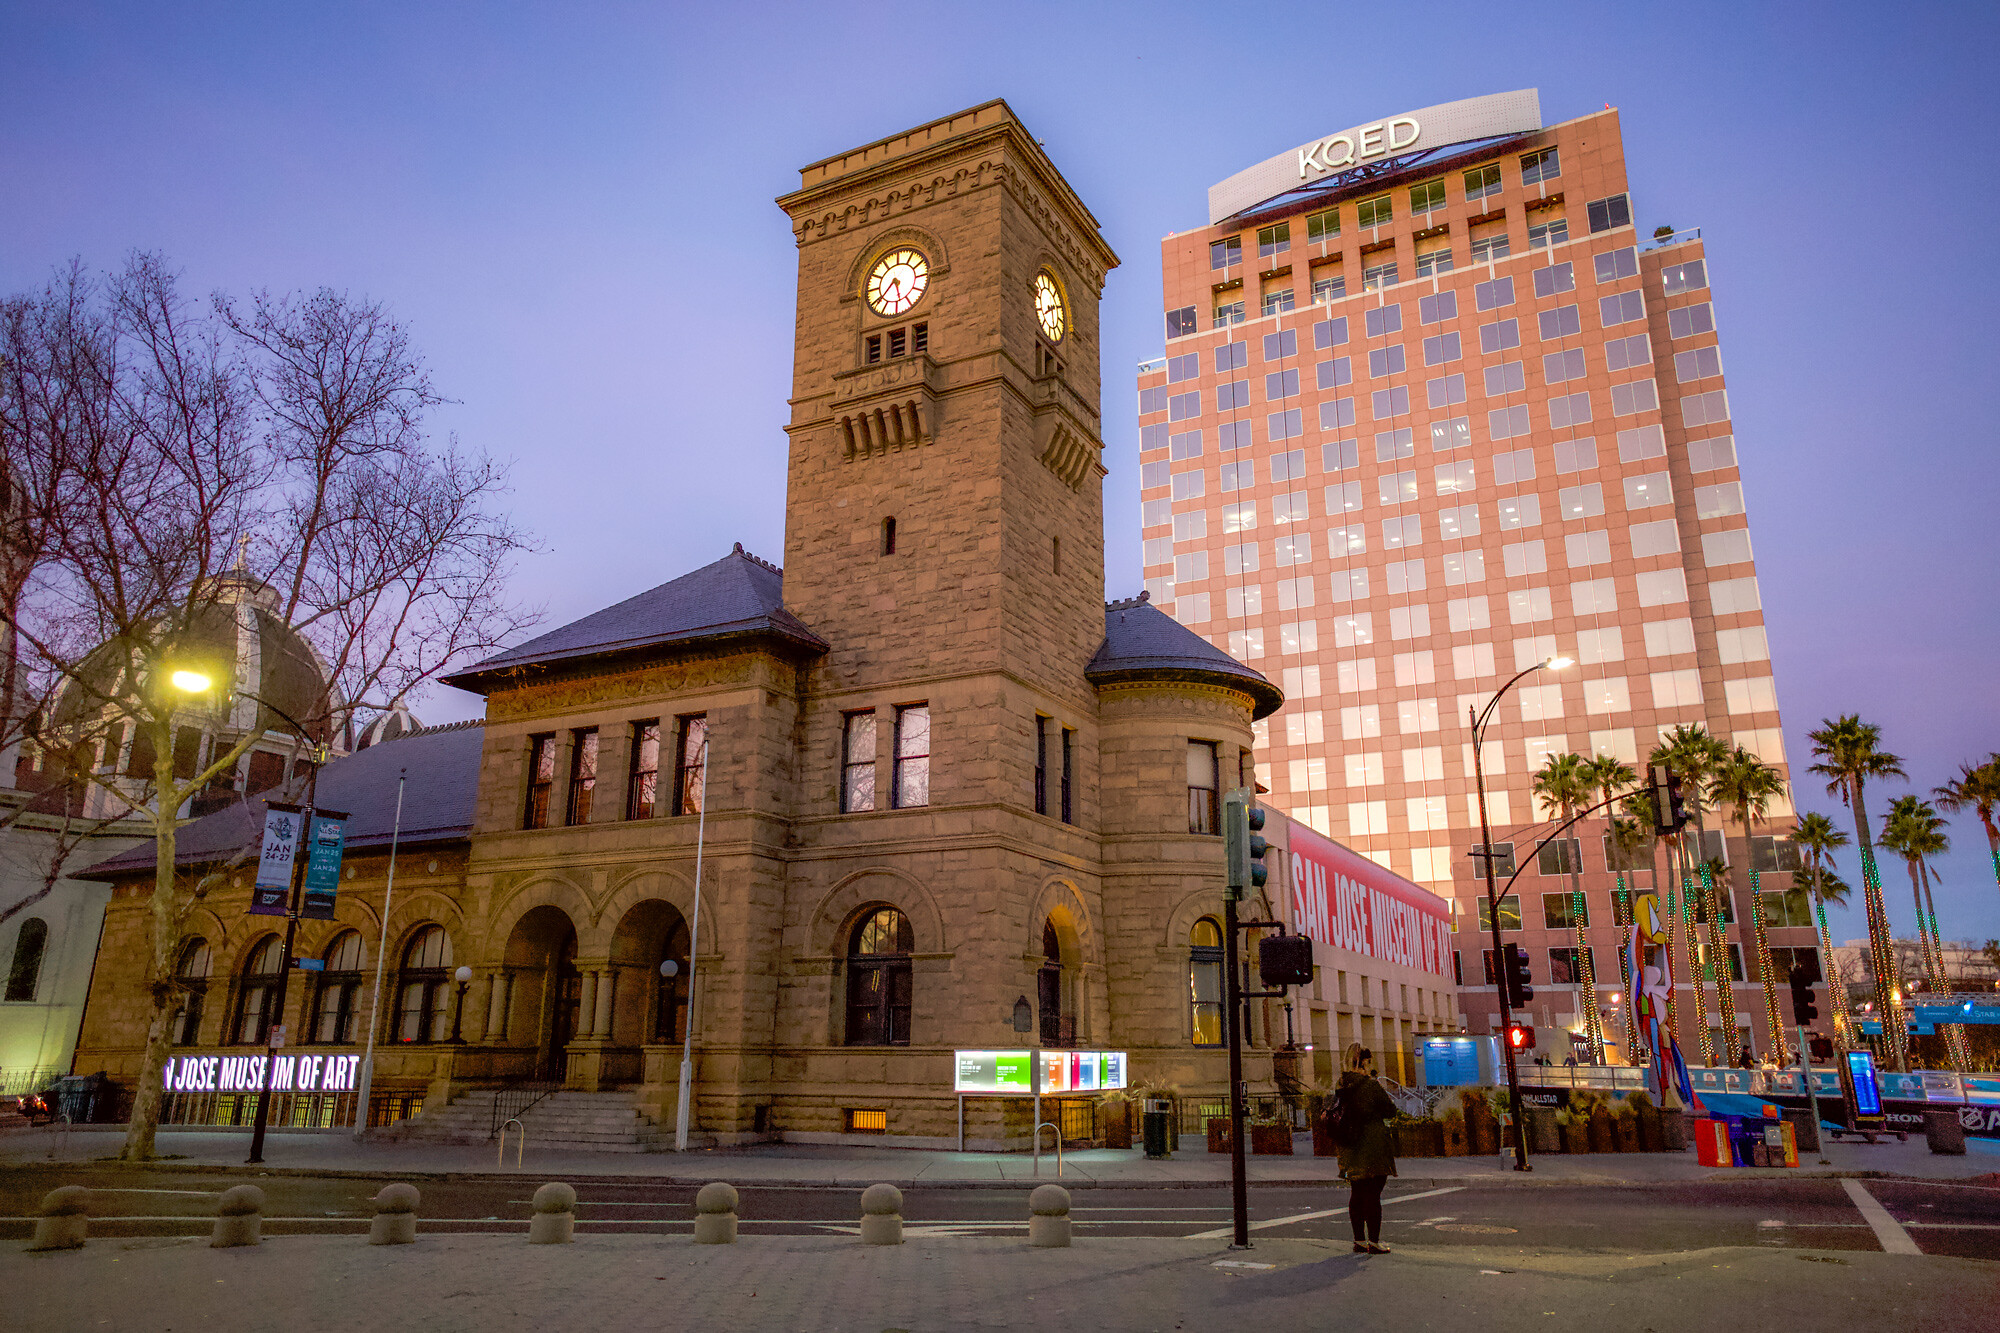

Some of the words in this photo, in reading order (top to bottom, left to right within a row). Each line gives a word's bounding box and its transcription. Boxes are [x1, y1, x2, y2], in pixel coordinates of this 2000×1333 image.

[1299, 117, 1420, 179] KQED
[265, 852, 290, 861] 24-27
[266, 843, 291, 853] JAN
[1292, 852, 1330, 944] SAN
[1332, 872, 1371, 956] JOSE
[1369, 888, 1424, 970] MUSEUM
[1422, 911, 1436, 974] OF
[1436, 919, 1456, 979] ART
[174, 1056, 218, 1091] JOSE
[297, 1056, 323, 1091] OF
[322, 1056, 360, 1091] ART
